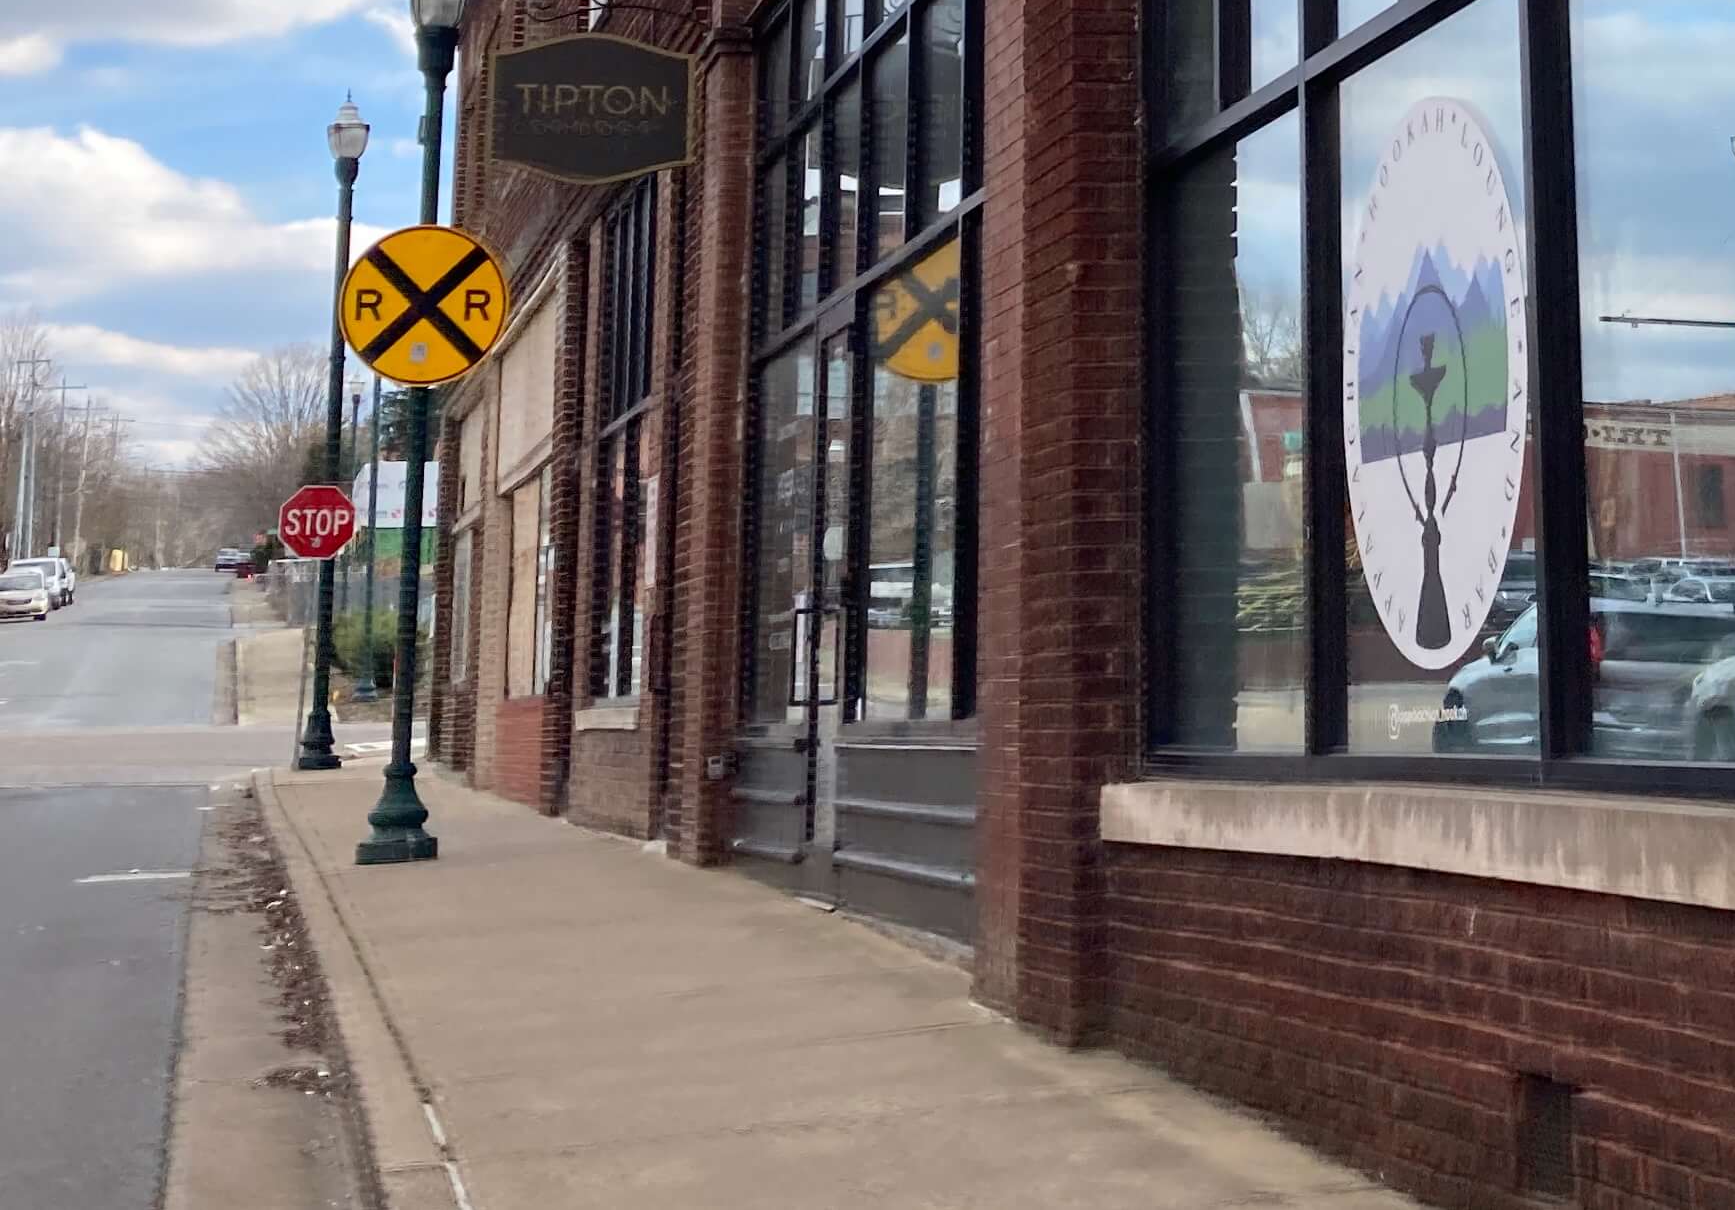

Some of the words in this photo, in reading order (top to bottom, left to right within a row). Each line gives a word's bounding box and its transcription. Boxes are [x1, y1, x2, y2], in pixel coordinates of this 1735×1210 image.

[512, 83, 669, 117] TIPTON
[1368, 106, 1445, 222] HOOKAH
[1461, 122, 1522, 320] LOUNGE
[355, 289, 383, 321] R
[463, 289, 491, 322] R
[284, 508, 350, 537] STOP
[1461, 548, 1498, 630] BAR
